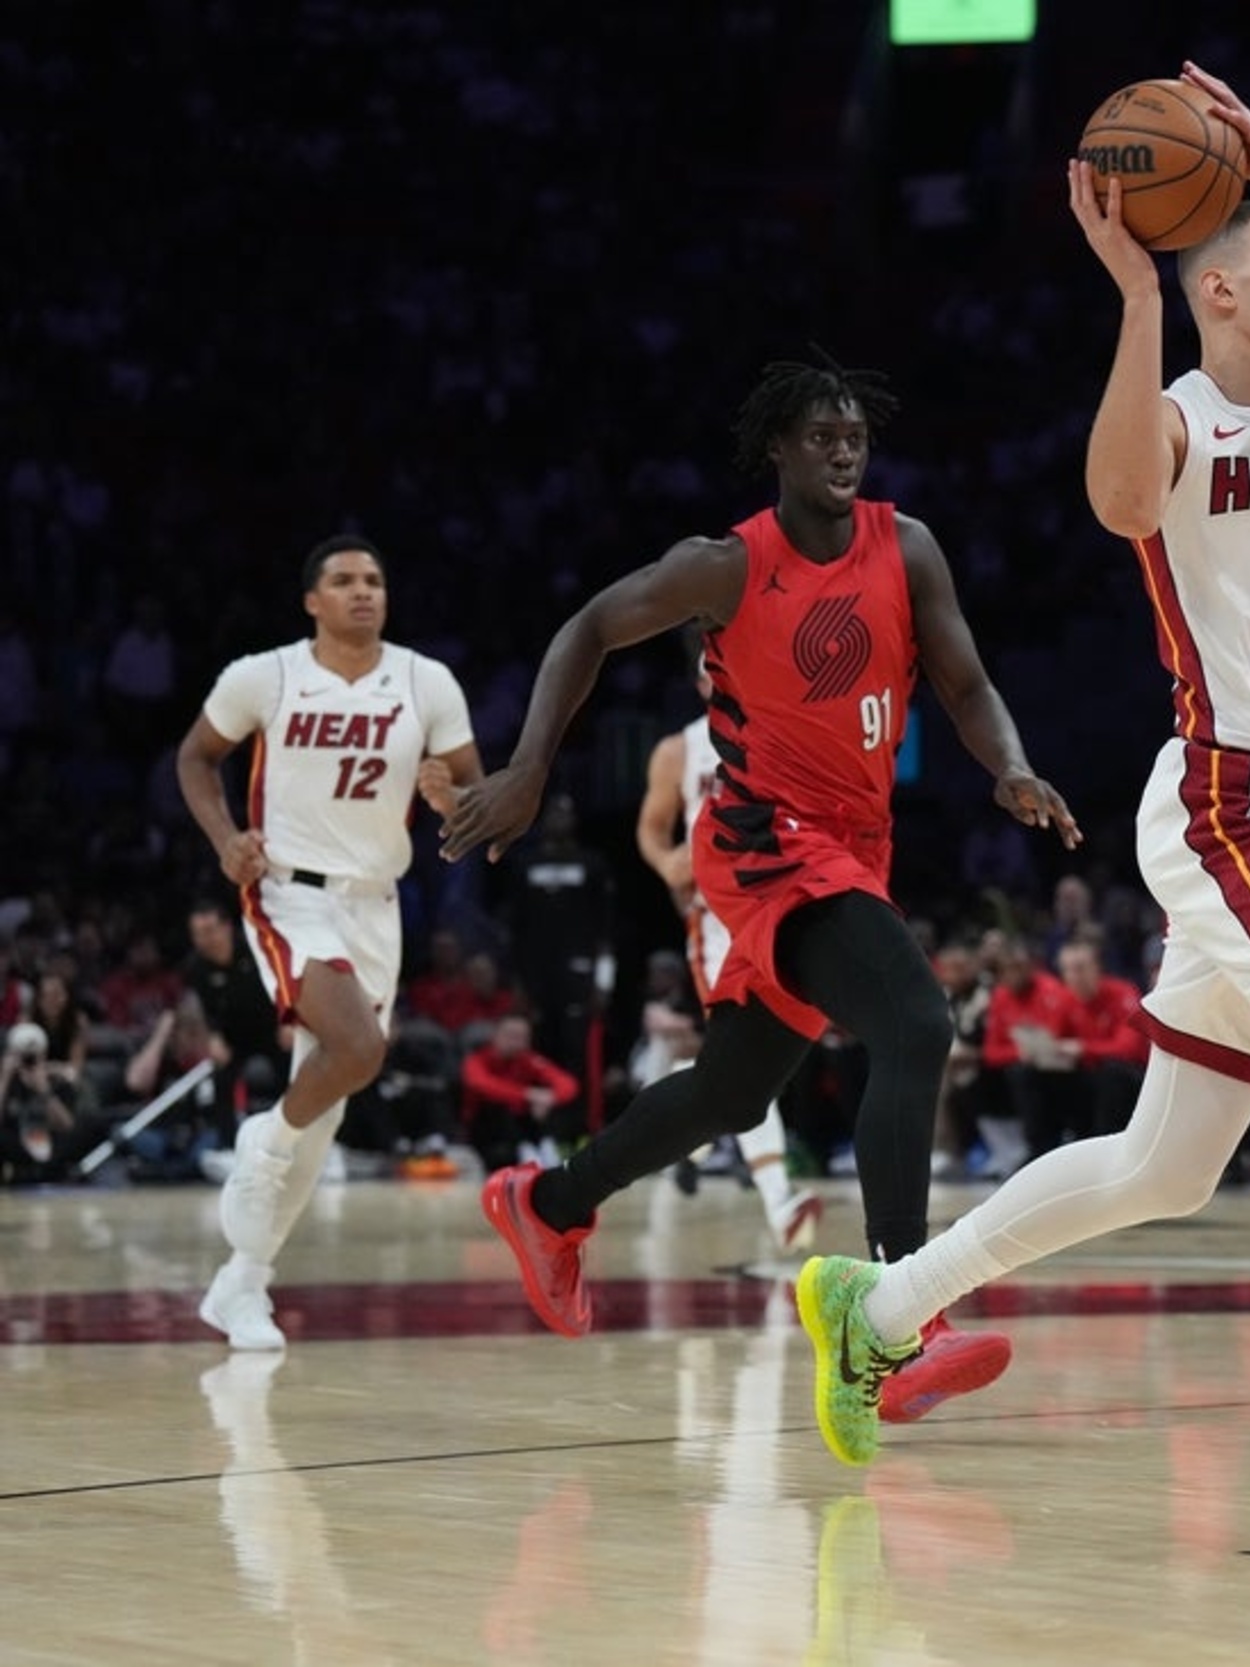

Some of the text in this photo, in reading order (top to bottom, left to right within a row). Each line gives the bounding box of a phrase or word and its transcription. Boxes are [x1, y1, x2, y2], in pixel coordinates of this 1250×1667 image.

[1079, 145, 1155, 176] Wil
[284, 702, 404, 750] HEAT
[859, 687, 892, 751] 91
[333, 756, 388, 800] 12
